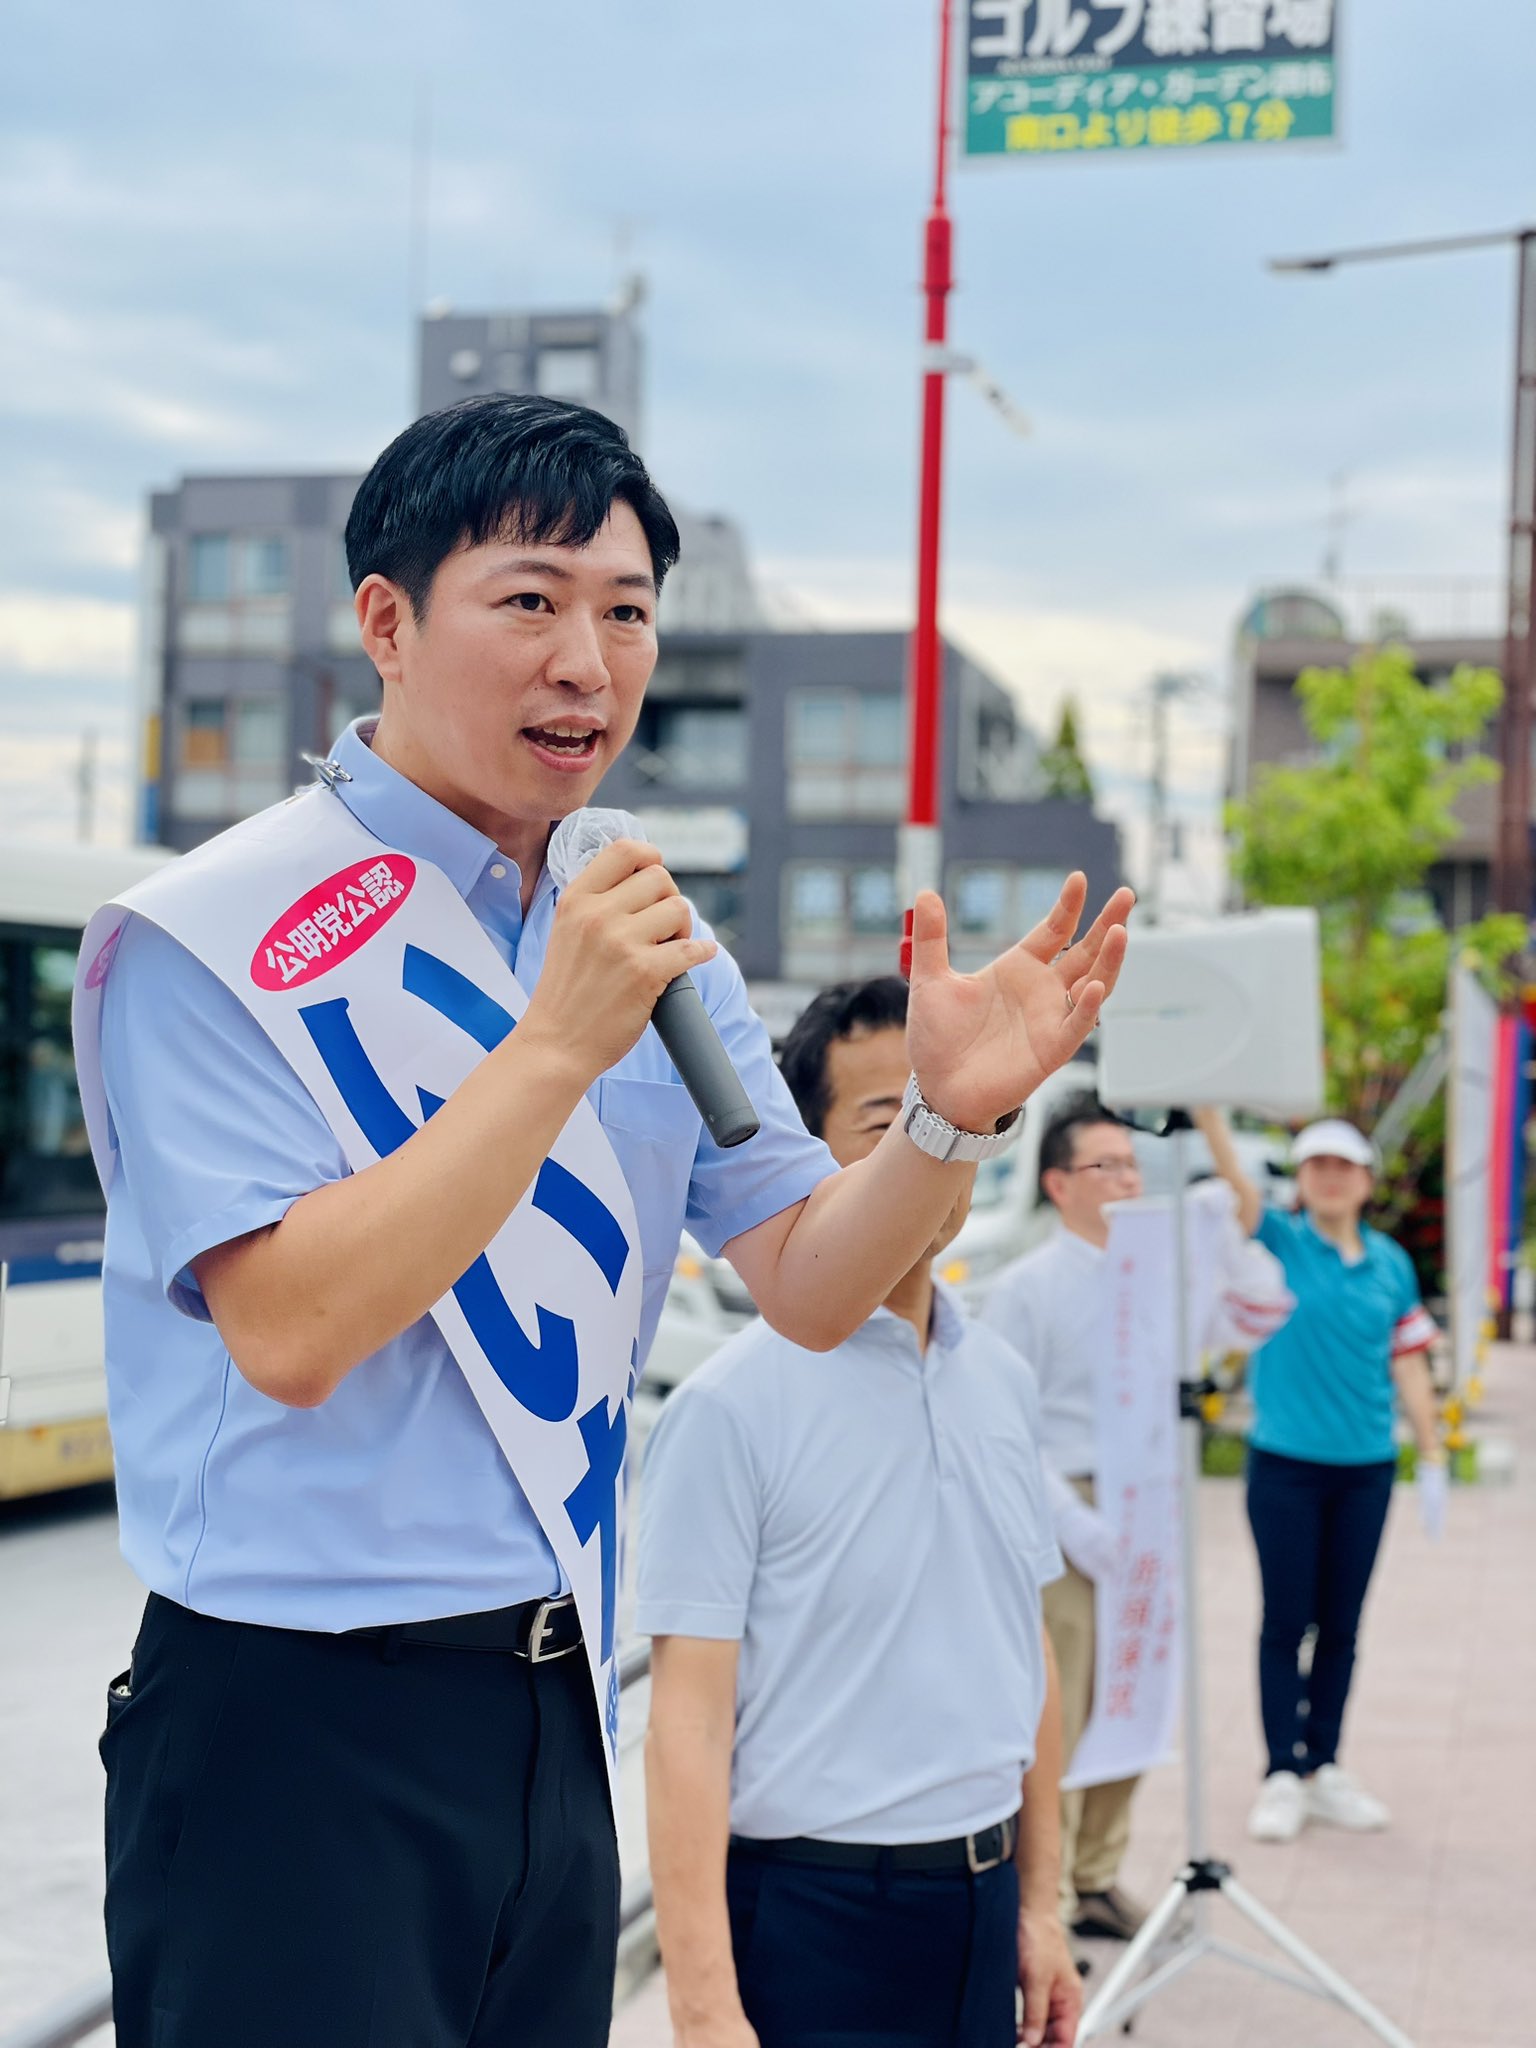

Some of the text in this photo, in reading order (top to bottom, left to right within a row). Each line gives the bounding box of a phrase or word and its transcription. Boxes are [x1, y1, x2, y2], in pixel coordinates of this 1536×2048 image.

[264, 861, 405, 984] 公明党公認
